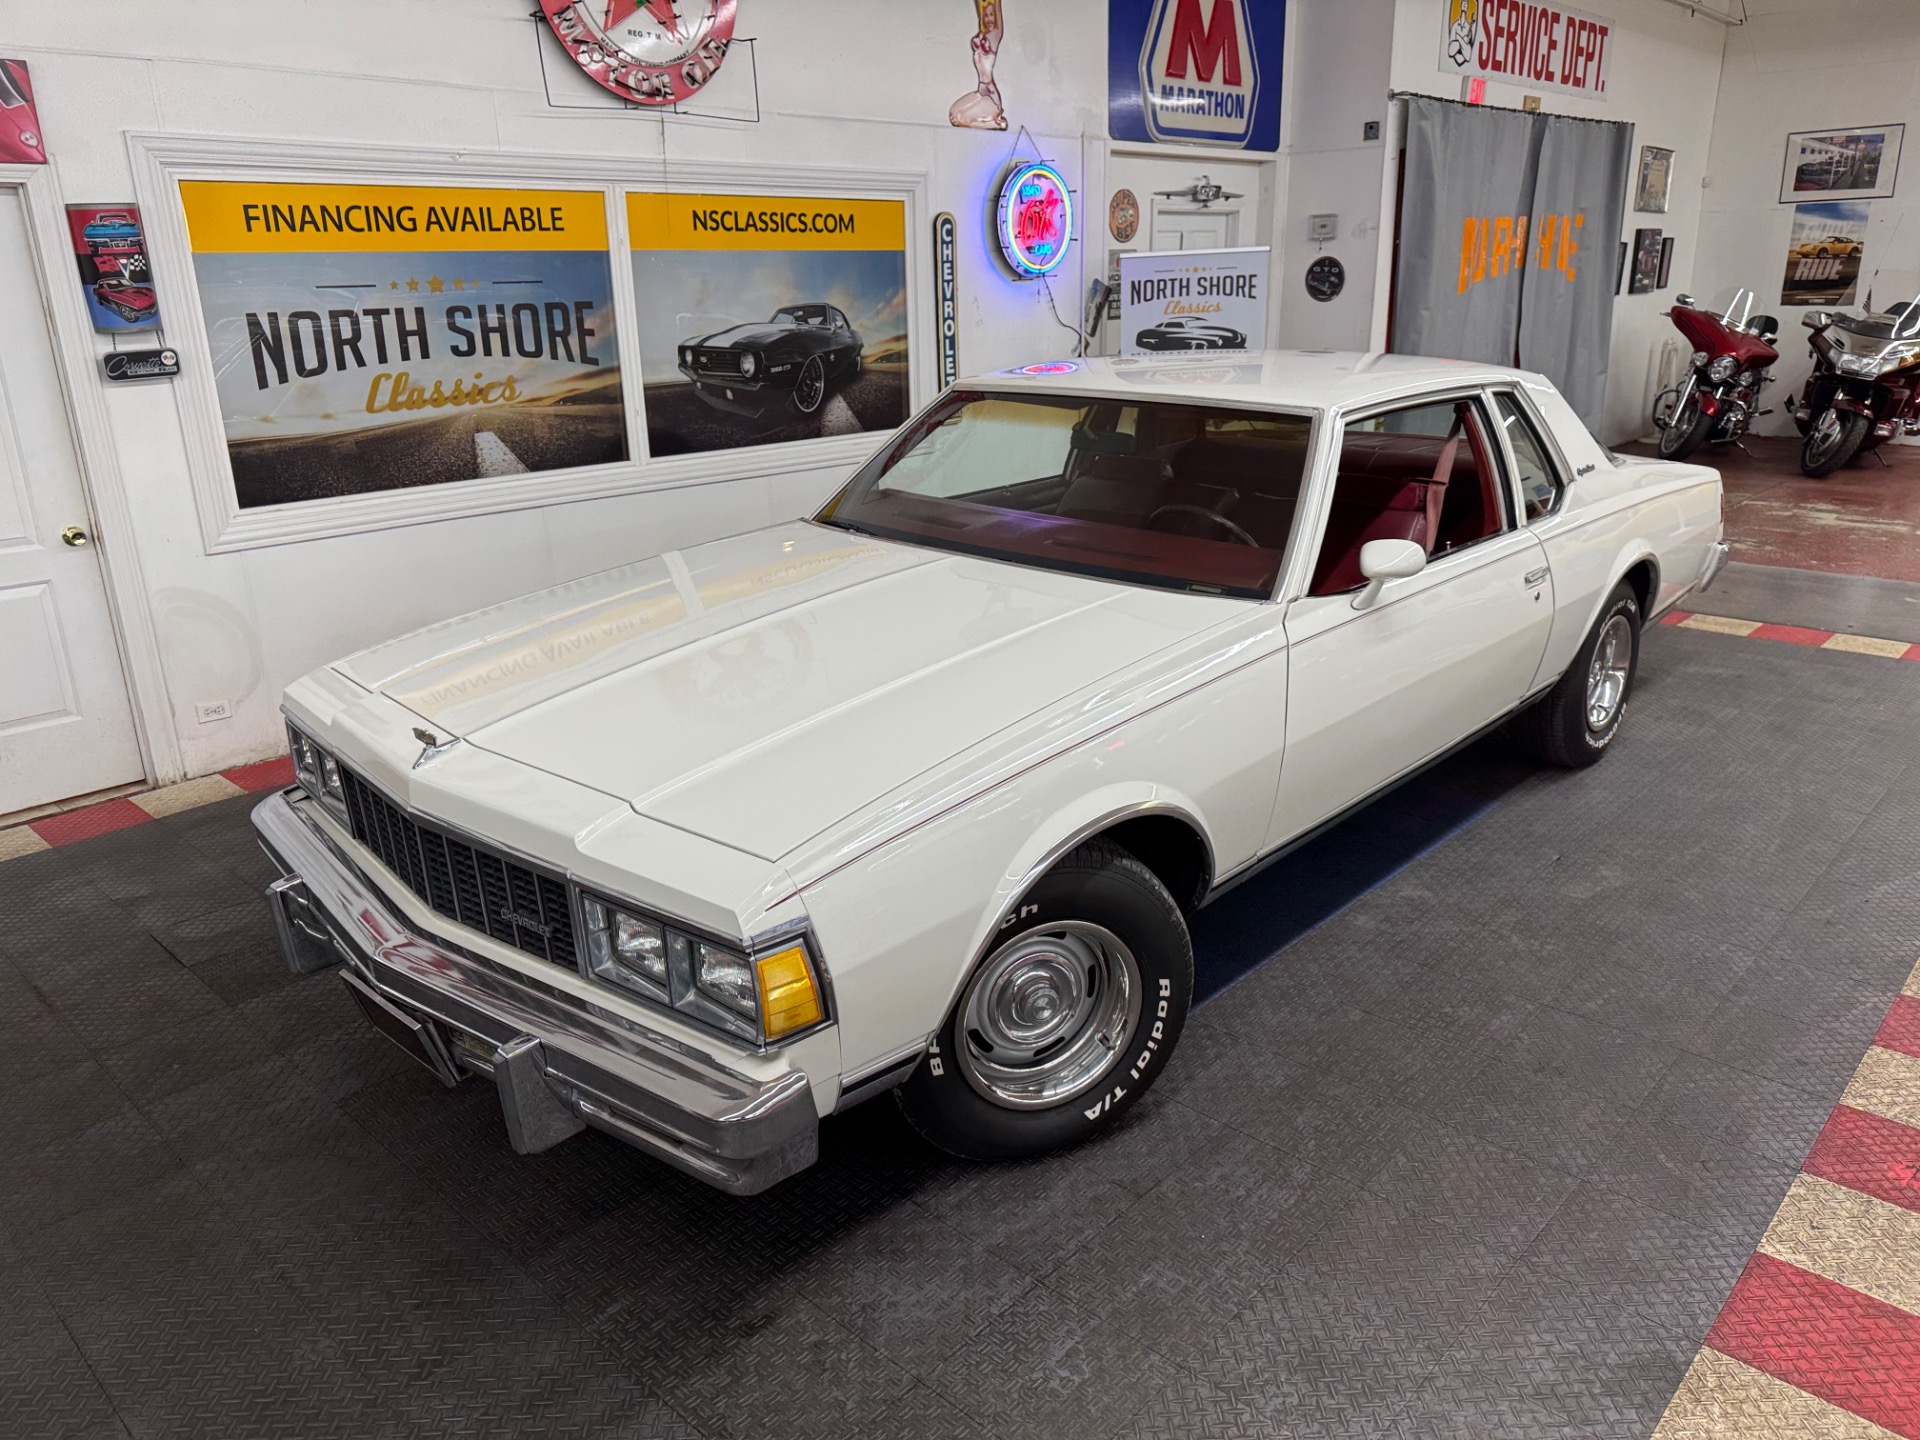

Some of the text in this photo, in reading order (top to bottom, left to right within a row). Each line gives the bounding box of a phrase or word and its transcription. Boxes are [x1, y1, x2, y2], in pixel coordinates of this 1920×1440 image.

[1478, 0, 1609, 92] SERVICE DEPT.
[1159, 84, 1246, 119] MARATHON
[243, 203, 565, 233] FINANCING AVAILABLE
[692, 209, 855, 233] NSCLASSICS.COM
[1312, 265, 1340, 274] GTO
[1793, 258, 1844, 280] RIDE
[942, 223, 957, 387] CHEVROLET
[1130, 277, 1190, 306] NORTH
[1197, 273, 1258, 300] SHORE
[1163, 299, 1223, 316] Classics
[245, 300, 600, 390] NORTH SHORE
[107, 355, 165, 376] Corvette
[365, 371, 523, 414] Classics
[500, 907, 552, 938] CHEVROLET
[1084, 978, 1171, 1121] Radial T/A
